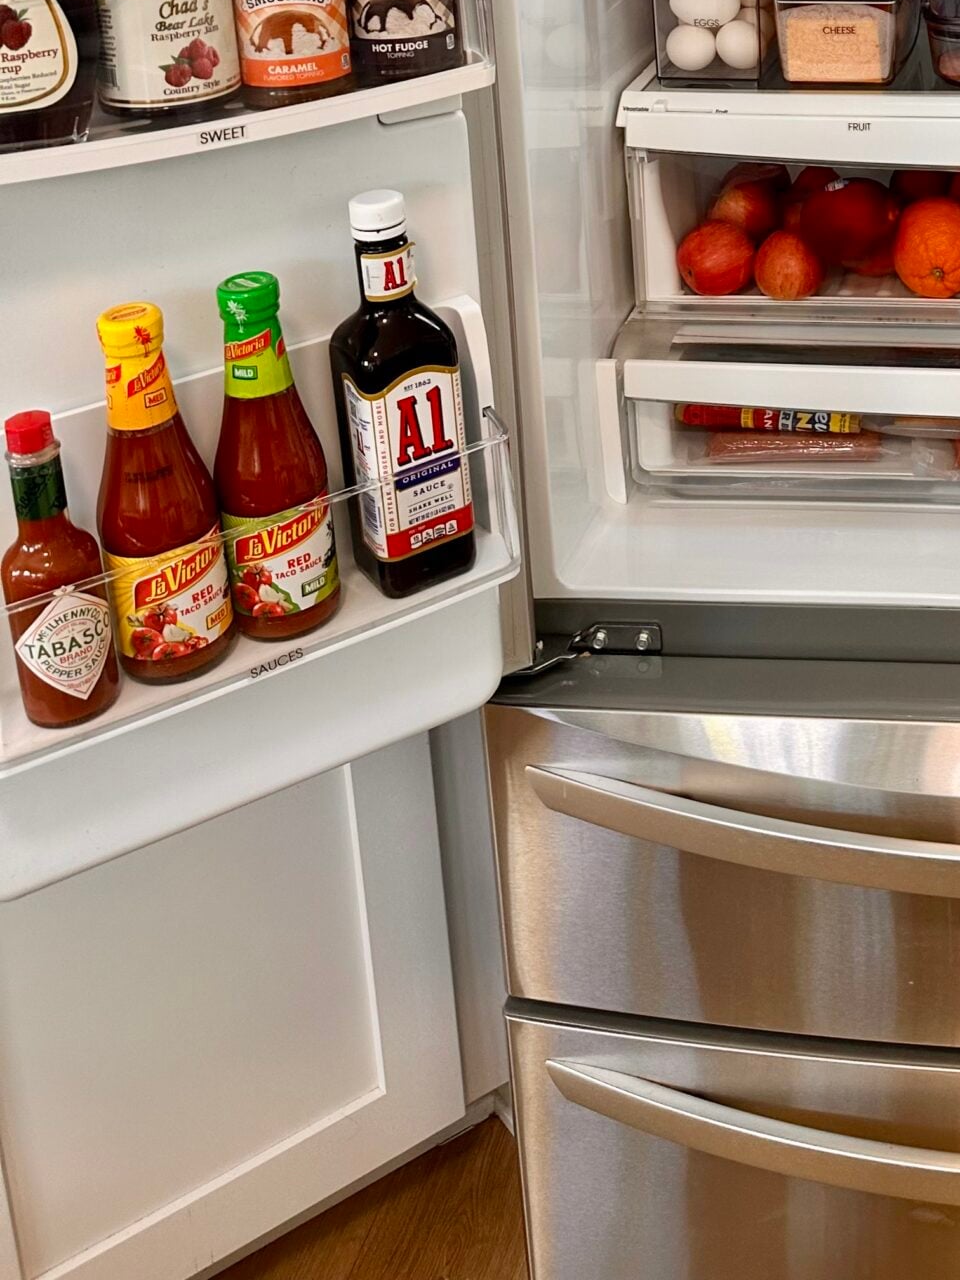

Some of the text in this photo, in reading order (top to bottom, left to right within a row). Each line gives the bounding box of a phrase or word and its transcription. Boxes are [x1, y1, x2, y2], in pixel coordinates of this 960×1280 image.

[155, 12, 214, 32] Bear Lake
[694, 19, 719, 27] EGGS
[822, 26, 857, 35] CHEESE
[151, 24, 219, 42] Raspberry Jam
[372, 40, 428, 52] HOT FUDGE
[1, 48, 58, 63] Raspberry
[387, 51, 414, 59] TOPPING
[267, 62, 317, 74] CARAMEL
[163, 79, 220, 96] Country Style
[200, 126, 246, 144] SWEET
[848, 123, 871, 132] FRUIT
[234, 368, 254, 378] MILD
[415, 378, 431, 389] 1862
[148, 394, 164, 404] MED
[402, 462, 453, 484] ORIGINAL
[413, 481, 446, 497] SAUCE
[409, 494, 453, 513] SHAKE WELL
[275, 555, 322, 580] TACO SAUCE
[287, 552, 311, 569] RED
[304, 576, 325, 593] MILD
[192, 584, 213, 603] RED
[180, 604, 201, 617] TACO
[210, 609, 226, 626] MED
[25, 611, 110, 660] TABASCO
[60, 645, 93, 664] BRAND
[251, 647, 304, 679] SAUCES
[41, 660, 82, 678] PEPPER
